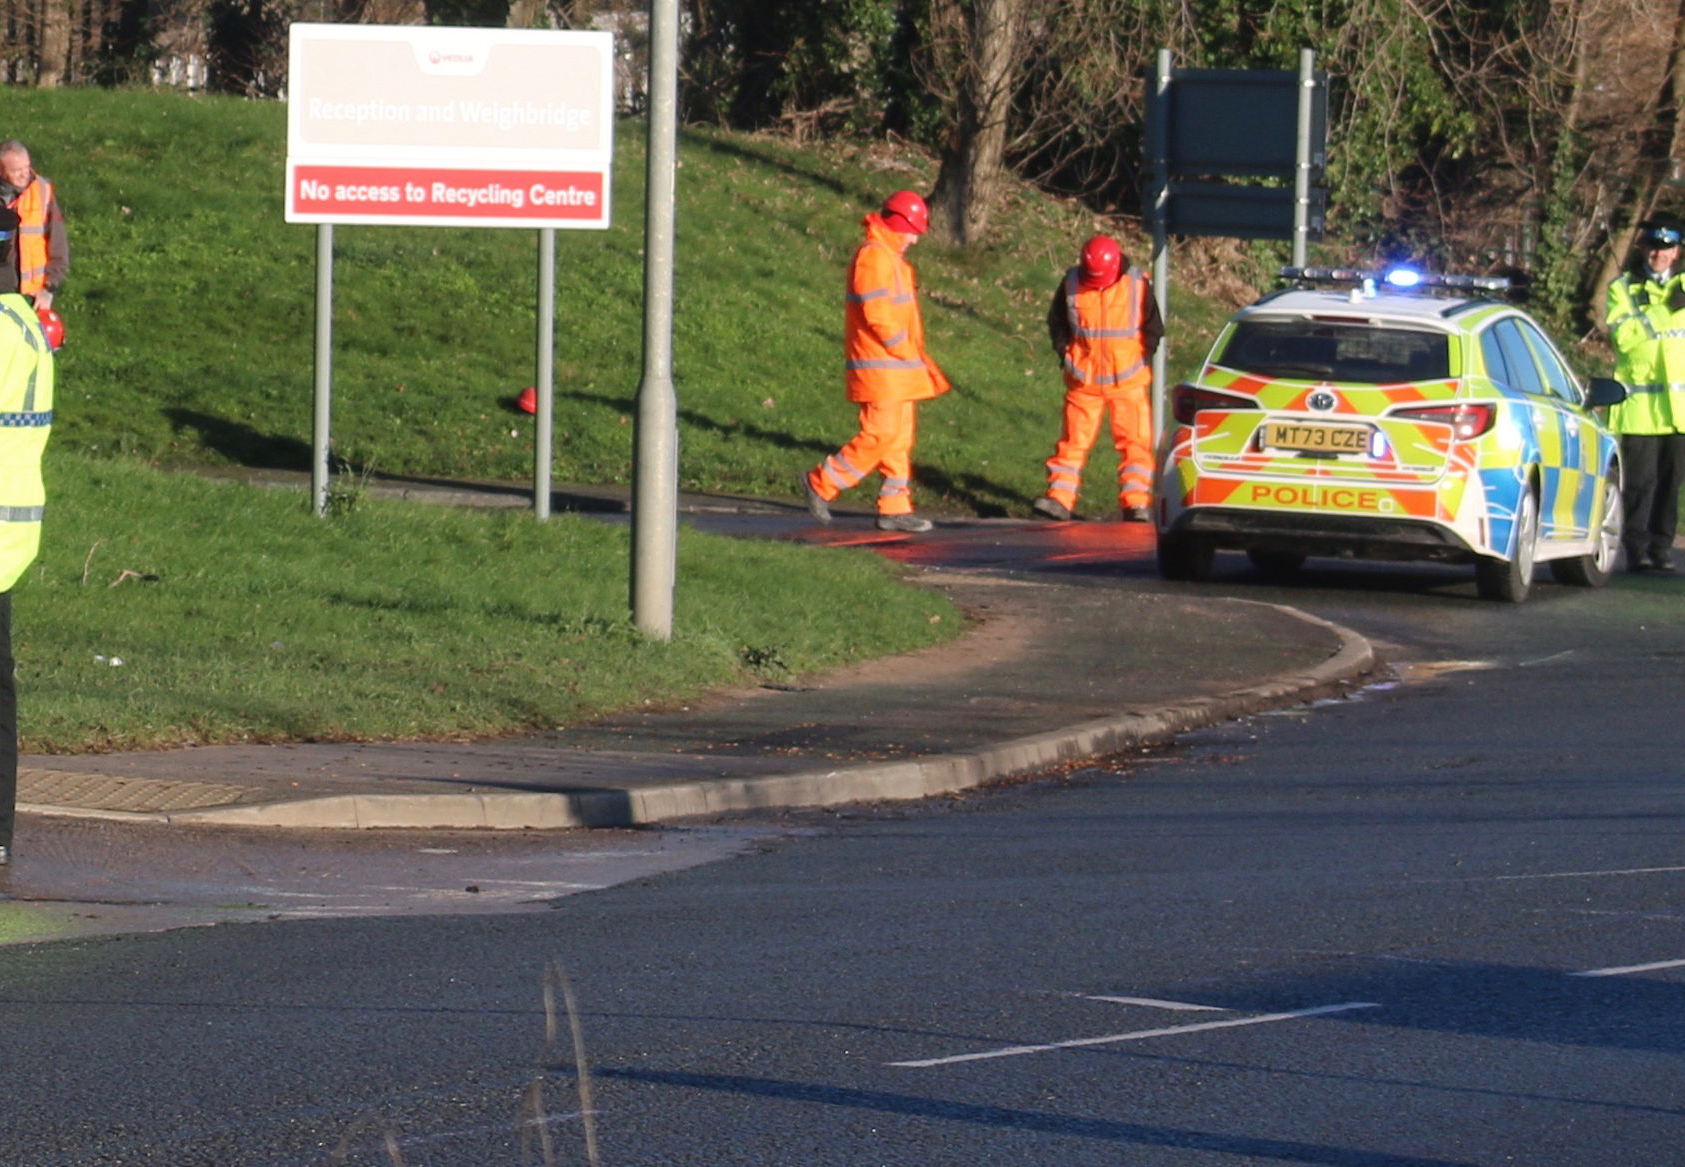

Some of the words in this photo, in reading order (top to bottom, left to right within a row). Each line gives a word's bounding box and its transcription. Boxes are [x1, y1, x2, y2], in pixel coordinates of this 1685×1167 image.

[309, 96, 411, 127] Reception
[418, 100, 455, 124] and
[460, 101, 592, 131] Weighbridge
[300, 179, 330, 201] No
[334, 184, 400, 202] access
[405, 182, 426, 203] to
[431, 183, 524, 208] Recycling
[529, 183, 596, 207] Centre
[1275, 426, 1326, 447] MT73
[1330, 429, 1368, 449] CZE
[1251, 484, 1379, 510] POLICE
